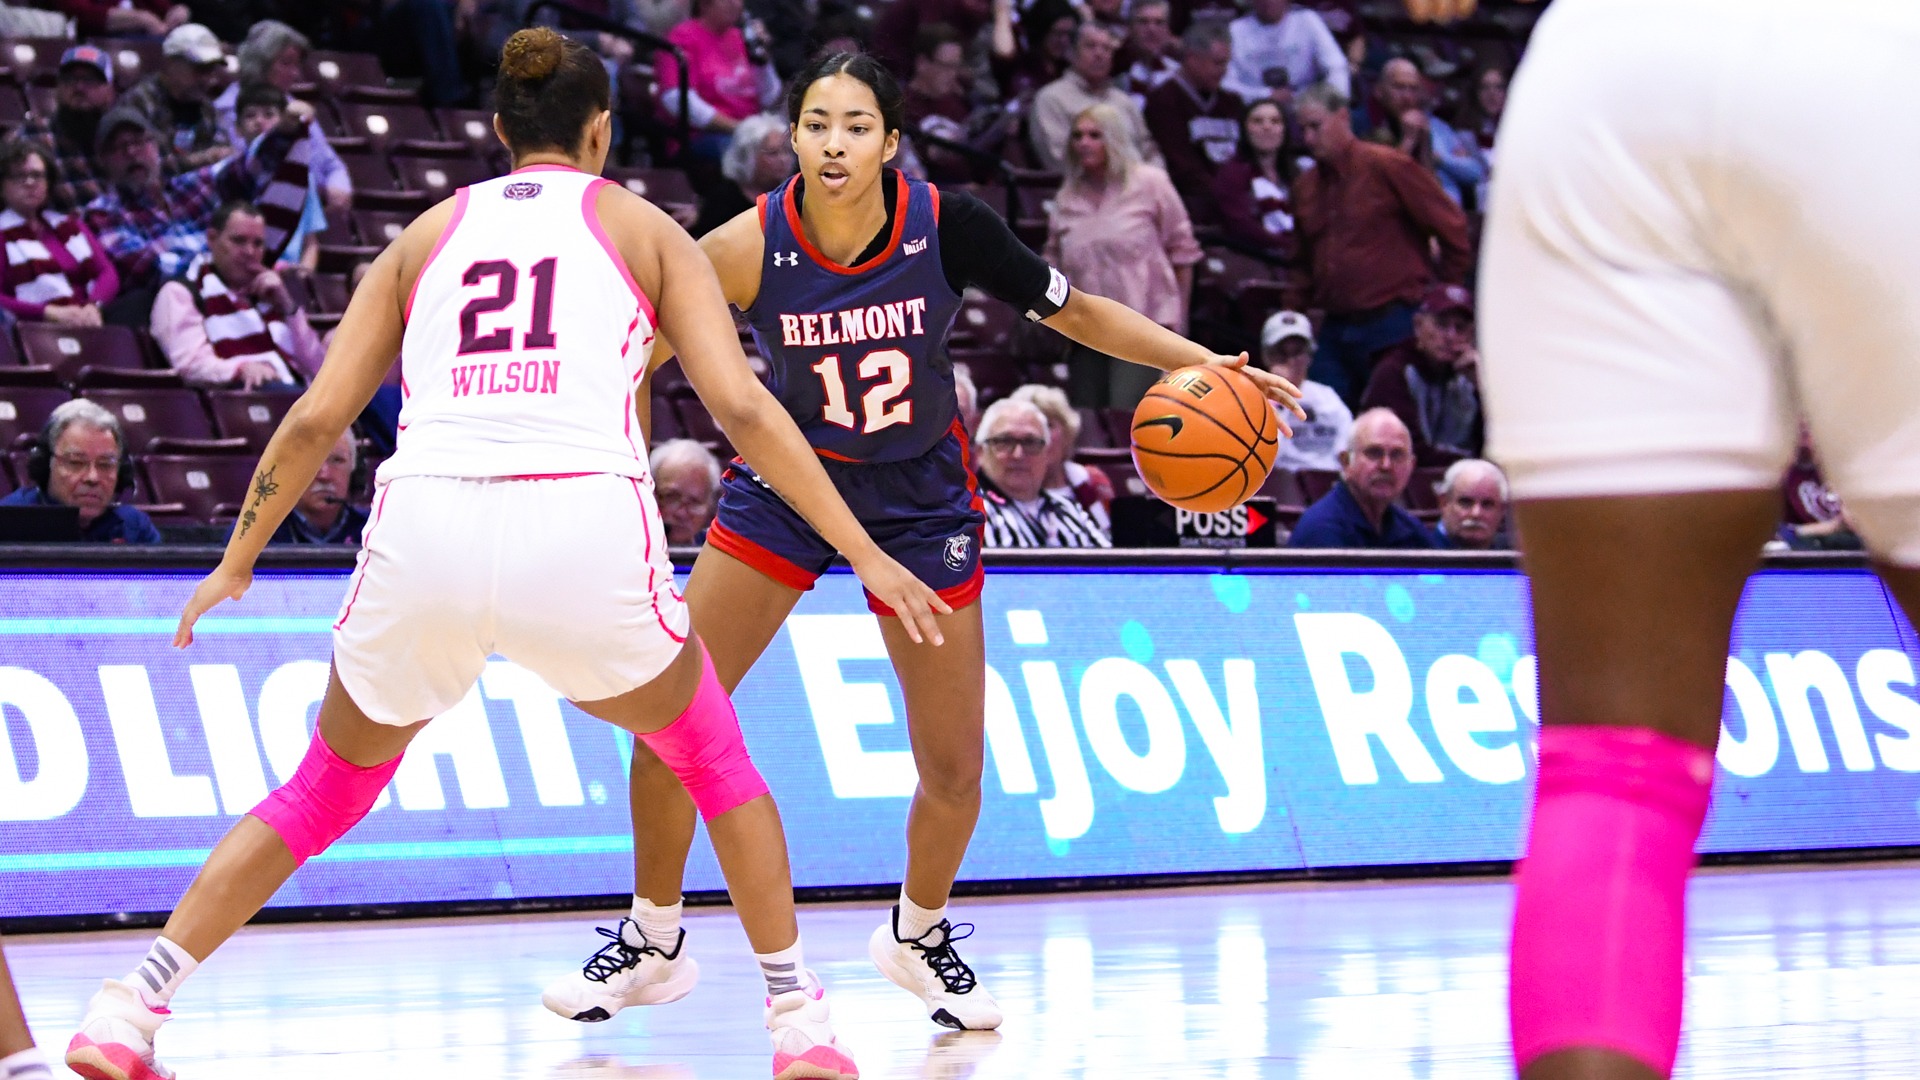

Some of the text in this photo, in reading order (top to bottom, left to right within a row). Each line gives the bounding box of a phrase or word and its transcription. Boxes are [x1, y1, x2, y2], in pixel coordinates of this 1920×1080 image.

[456, 257, 558, 357] 21
[780, 297, 926, 346] BELMONT
[451, 361, 560, 398] WILSON
[810, 347, 913, 434] 12
[1176, 503, 1248, 536] POSS
